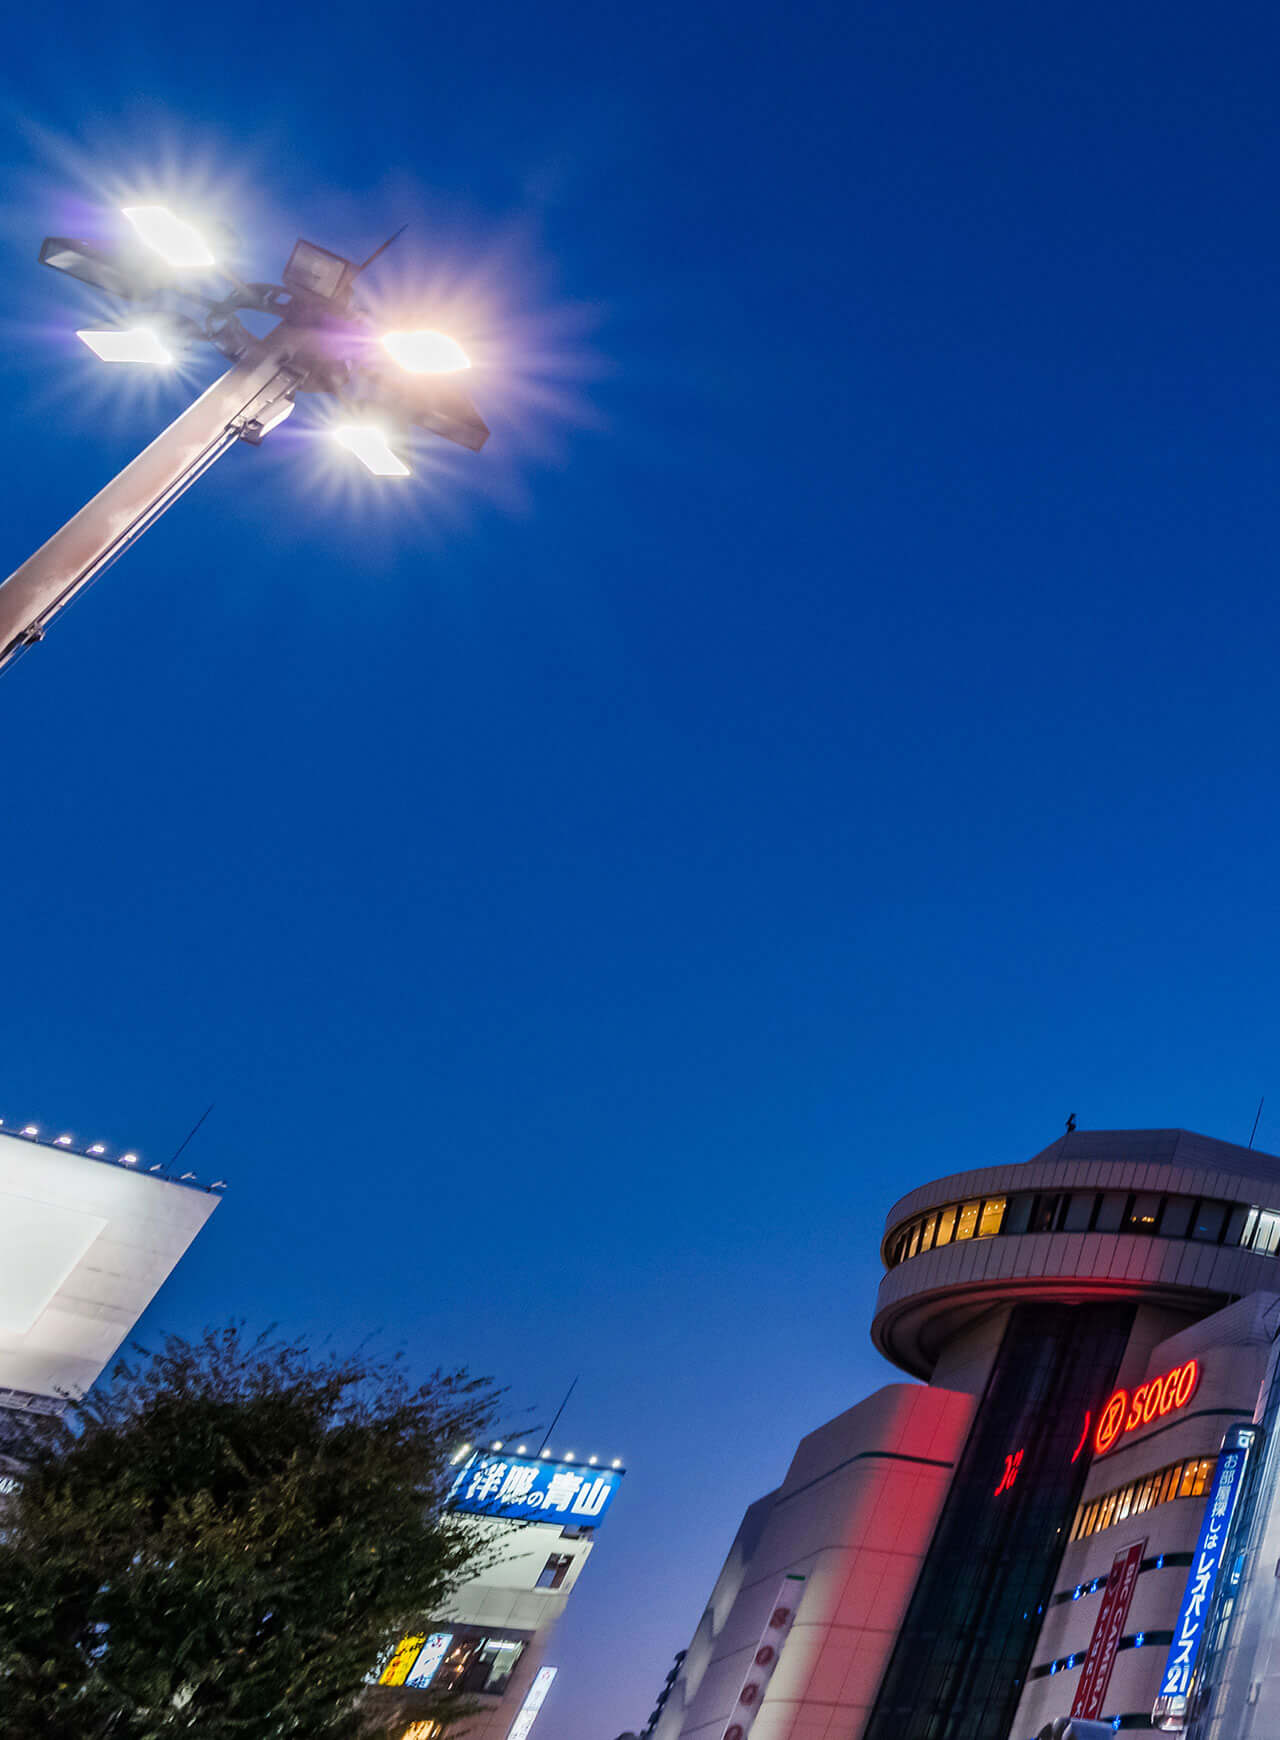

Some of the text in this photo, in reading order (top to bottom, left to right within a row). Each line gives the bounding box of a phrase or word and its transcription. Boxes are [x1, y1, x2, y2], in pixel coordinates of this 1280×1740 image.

[1125, 1359, 1198, 1432] SOGO
[465, 1462, 611, 1517] 洋服の青山
